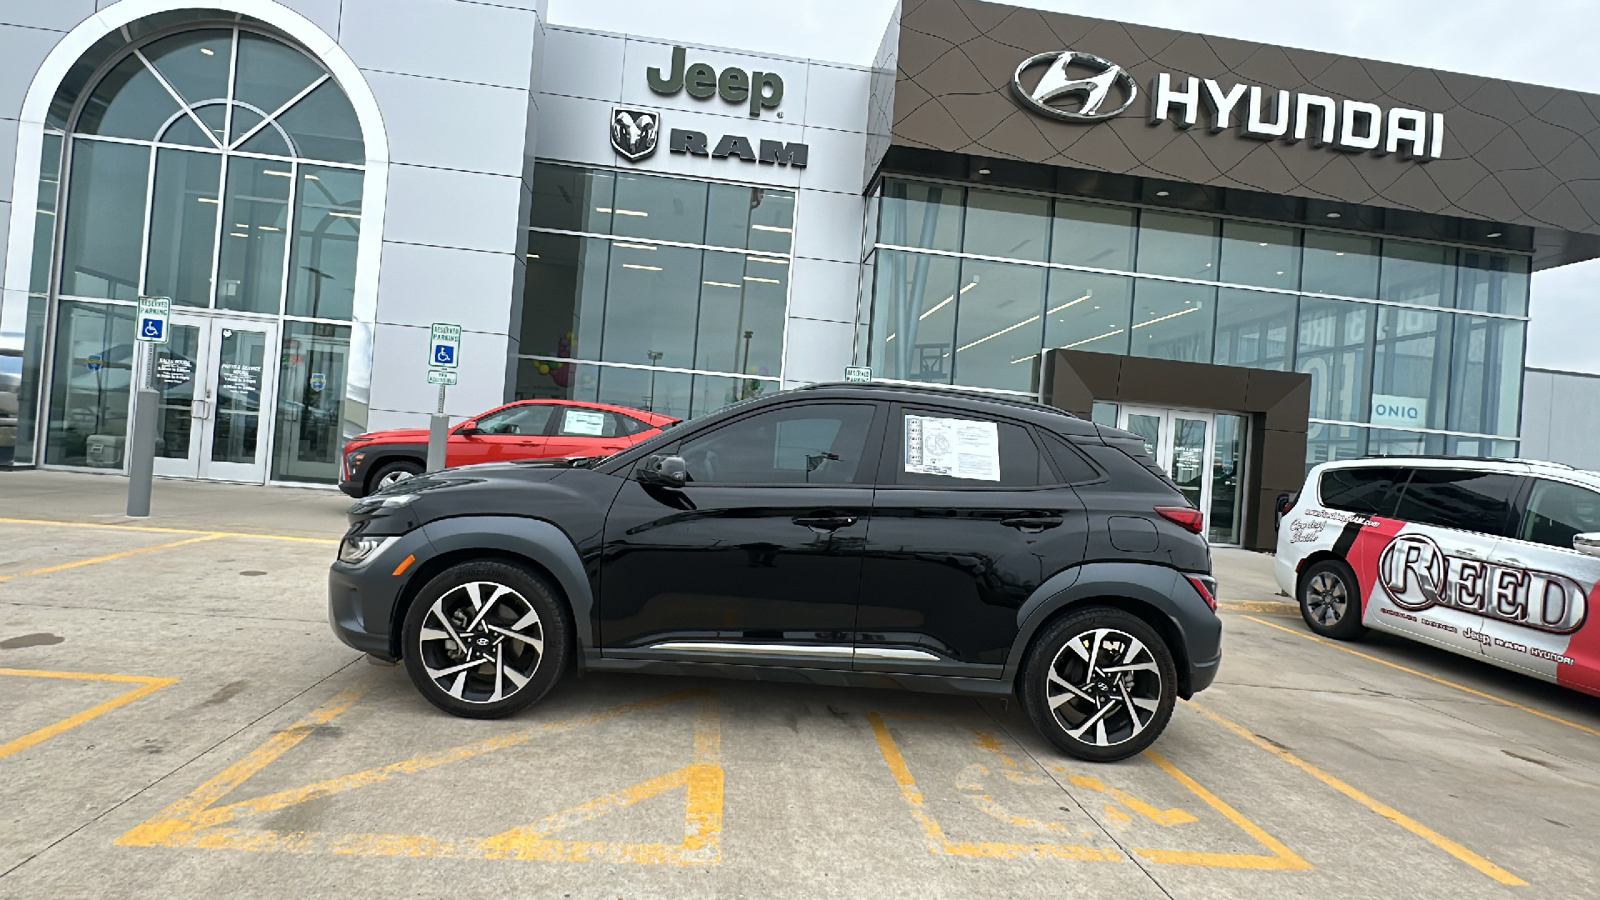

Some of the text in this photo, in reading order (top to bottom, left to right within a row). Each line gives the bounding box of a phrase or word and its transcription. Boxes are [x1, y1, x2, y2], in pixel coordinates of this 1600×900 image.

[646, 46, 784, 117] Jeep
[1150, 71, 1444, 162] HYUNDAI
[669, 128, 809, 168] RAM
[141, 299, 168, 308] RESERVED
[141, 307, 168, 316] PARKING
[433, 334, 459, 342] PARKING
[434, 326, 459, 335] RESERVED
[1371, 404, 1418, 419] ONIQ
[1378, 533, 1589, 635] REED
[1463, 627, 1491, 646] Jeep
[1494, 637, 1527, 653] RAM
[1530, 646, 1575, 666] HYUNDAI
